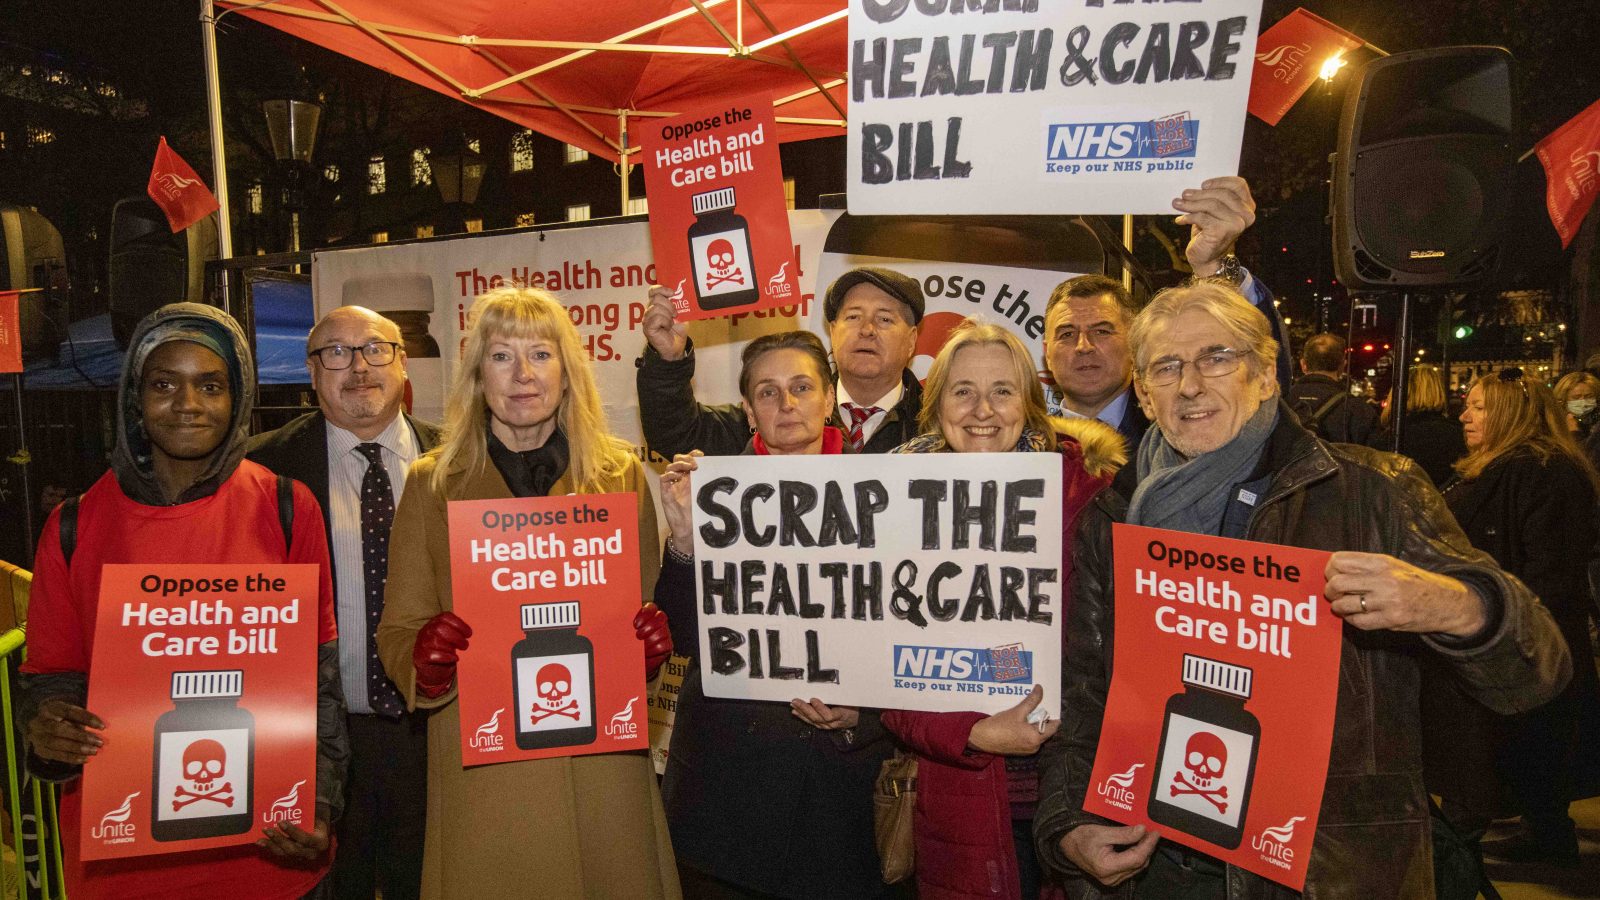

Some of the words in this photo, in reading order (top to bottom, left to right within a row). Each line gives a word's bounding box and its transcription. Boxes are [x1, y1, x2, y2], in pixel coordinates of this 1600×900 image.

[852, 28, 1053, 102] HEALTH
[1099, 16, 1248, 83] CARE
[661, 115, 721, 141] Oppose
[724, 107, 752, 125] the
[1155, 115, 1185, 131] NOT
[1158, 128, 1186, 142] FOR
[656, 134, 721, 168] Health
[726, 123, 765, 151] and
[861, 117, 973, 184] BILL
[1050, 124, 1135, 158] NHS
[1157, 138, 1192, 155] SALE
[671, 164, 716, 187] Care
[720, 150, 754, 177] bill
[1046, 163, 1080, 174] Keep
[1085, 163, 1109, 172] our
[1113, 160, 1143, 172] NHS
[1147, 160, 1194, 173] public
[456, 267, 504, 297] The
[511, 259, 602, 291] Health
[911, 274, 986, 303] ose
[992, 283, 1045, 340] the
[583, 334, 622, 362] HS.
[482, 510, 568, 532] Oppose
[573, 504, 609, 524] the
[697, 476, 889, 549] SCRAP
[908, 479, 1046, 552] THE
[471, 533, 566, 563] Health
[572, 529, 623, 557] and
[1147, 540, 1246, 574] Oppose
[1253, 555, 1301, 583] the
[140, 574, 239, 597] Oppose
[245, 573, 286, 592] the
[491, 567, 557, 592] Care
[563, 559, 607, 587] bill
[701, 560, 884, 620] HEALTH
[926, 561, 1058, 626] CARE
[1135, 568, 1242, 613] Health
[1250, 594, 1317, 626] and
[121, 600, 234, 626] Health
[241, 598, 299, 624] and
[142, 631, 219, 657] Care
[227, 628, 278, 655] bill
[1155, 605, 1228, 644] Care
[1237, 618, 1292, 659] bill
[708, 626, 840, 684] BILL
[896, 647, 974, 679] NHS
[991, 646, 1019, 661] NOT
[995, 658, 1021, 669] FOR
[894, 679, 926, 691] Keep
[930, 682, 952, 692] our
[956, 682, 984, 693] NHS
[988, 686, 1032, 696] public
[995, 668, 1026, 681] SALE
